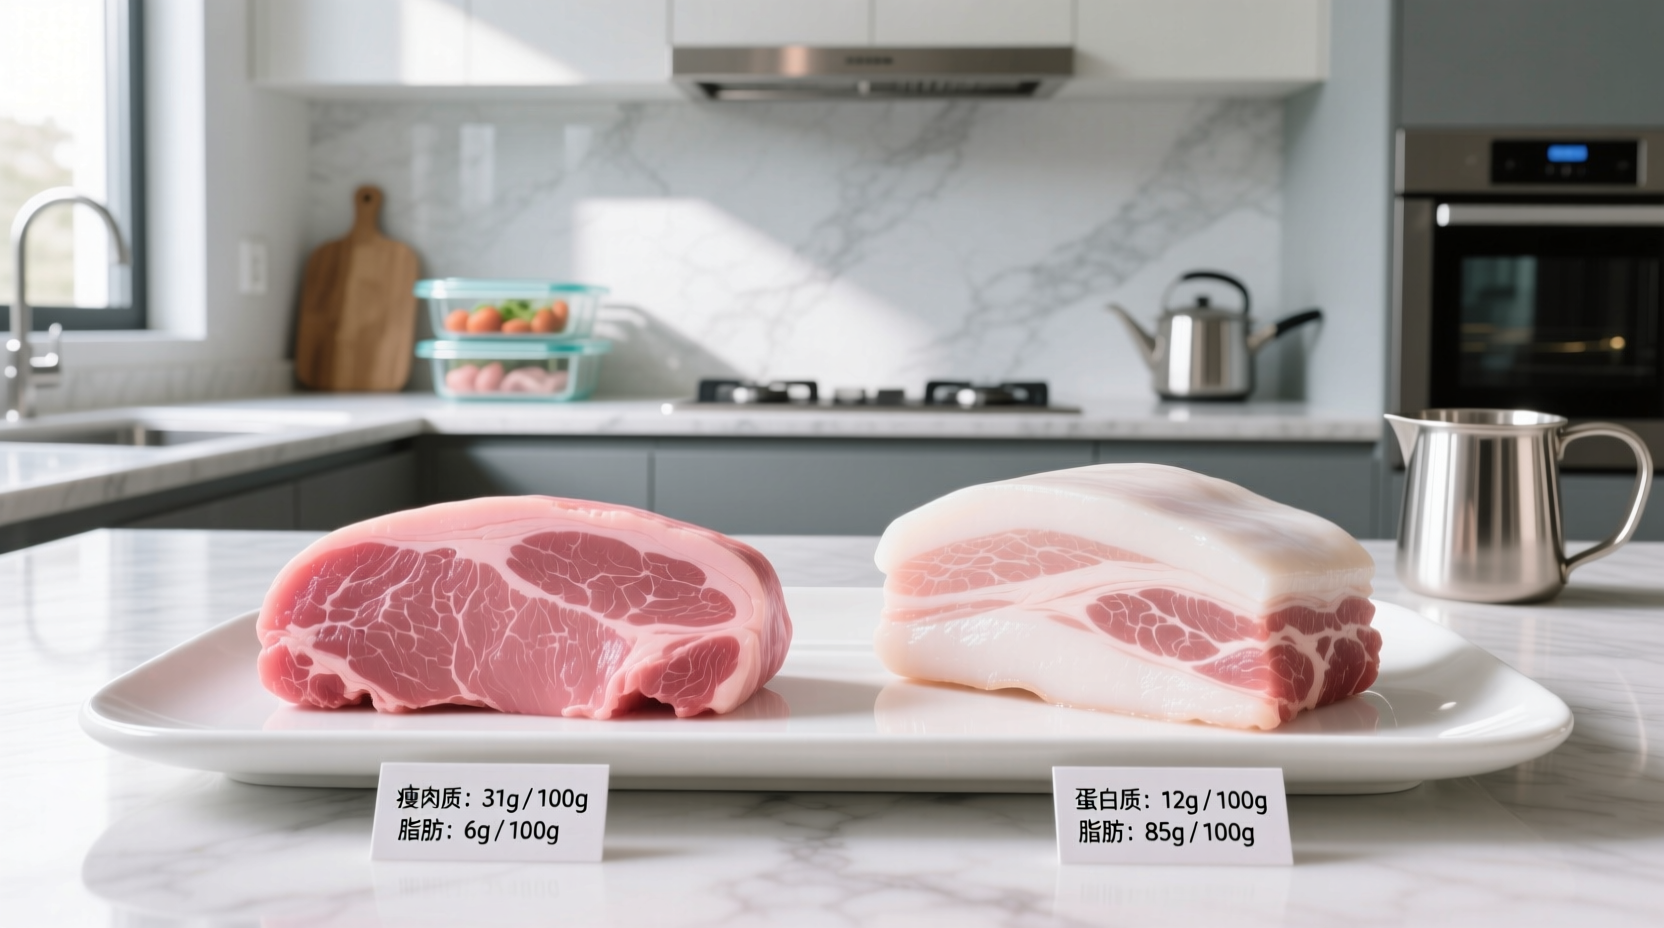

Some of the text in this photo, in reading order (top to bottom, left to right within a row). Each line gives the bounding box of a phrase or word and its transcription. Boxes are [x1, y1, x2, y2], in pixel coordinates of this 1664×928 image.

[1074, 787, 1150, 811] 蛋白质：
[397, 816, 452, 842] 脂肪：
[1078, 818, 1133, 844] 脂肪：
